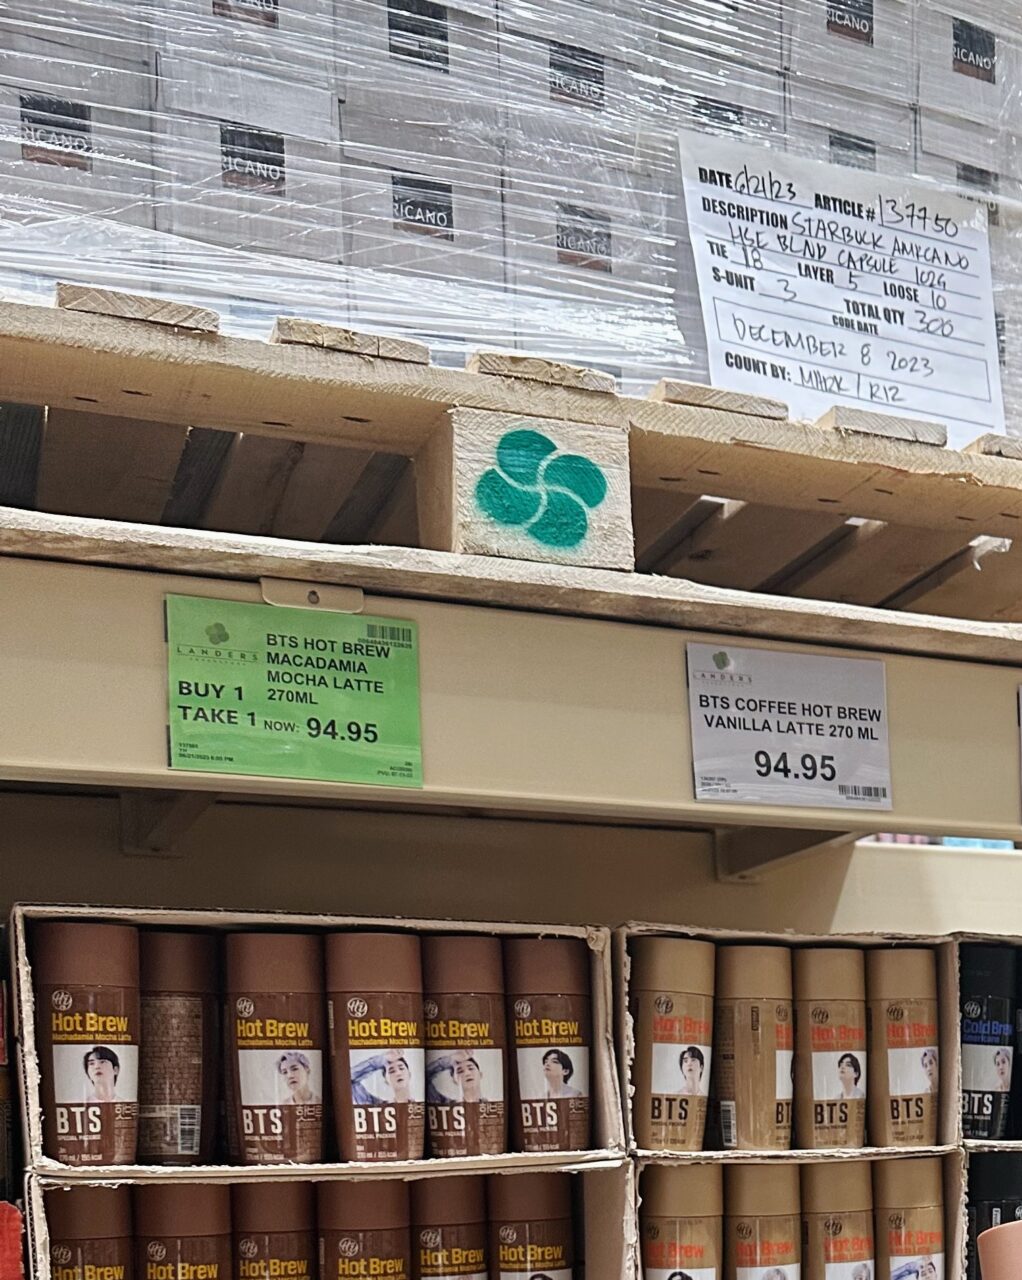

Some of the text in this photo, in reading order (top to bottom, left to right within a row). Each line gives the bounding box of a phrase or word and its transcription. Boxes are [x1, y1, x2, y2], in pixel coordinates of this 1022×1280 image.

[698, 167, 733, 190] DATE
[814, 193, 864, 220] ARTICLE
[878, 194, 959, 238] 137750
[701, 197, 885, 249] DESCRIPTION STARBUCK
[707, 240, 947, 310] TIE 18 LAYER 5 LOOSE 10
[838, 249, 899, 275] CAPSULE
[712, 266, 954, 337] S-UNIT 3 TOTAL QTY 300
[832, 314, 879, 336] CODE DATE
[732, 313, 934, 377] DECEMBER 8 2023
[725, 352, 791, 382] COUNT BY:
[267, 633, 298, 648] BTS
[304, 638, 337, 653] HOT
[342, 643, 390, 658] BREW
[267, 652, 368, 674] MACADAMIA
[178, 681, 243, 701] BUY 1
[267, 670, 384, 693] MOCHA LATTE
[267, 689, 318, 705] 270ML
[699, 695, 882, 722] BTS COFFEE HOT BREW
[177, 705, 379, 743] TAKE 1 NOW: 94.95
[704, 714, 879, 740] VANILLA LATTE 270 ML
[754, 750, 837, 781] 94.95
[52, 1012, 128, 1032] Hot Brew
[348, 1019, 417, 1037] Hot Brew
[56, 1106, 102, 1134] BTS
[354, 1106, 396, 1133] BTS
[651, 1097, 689, 1120] BTS
